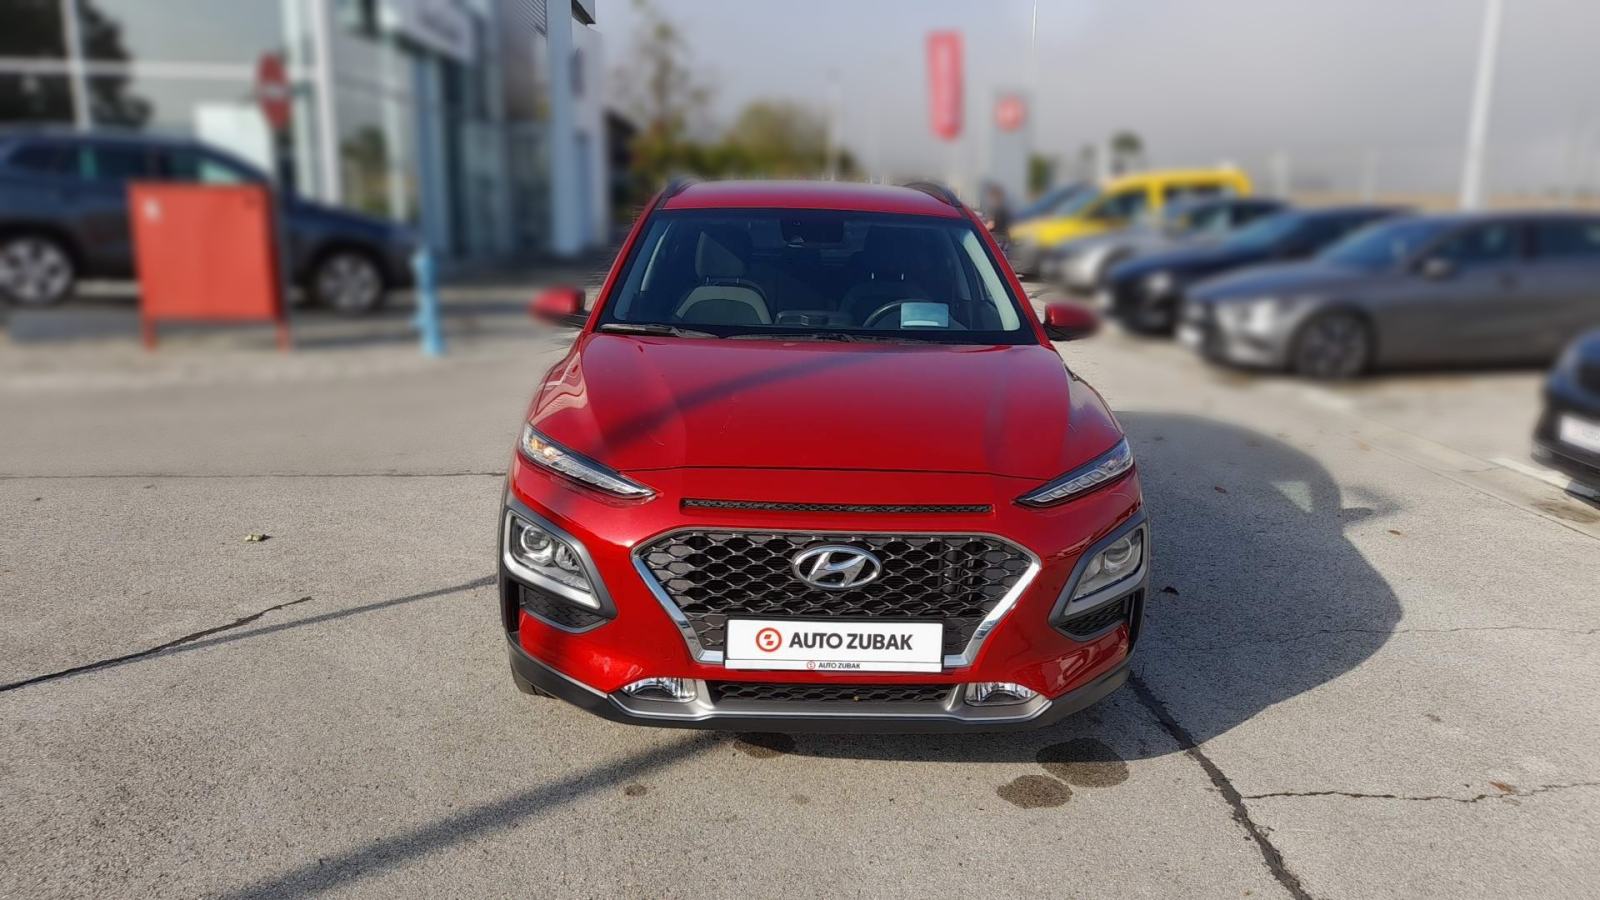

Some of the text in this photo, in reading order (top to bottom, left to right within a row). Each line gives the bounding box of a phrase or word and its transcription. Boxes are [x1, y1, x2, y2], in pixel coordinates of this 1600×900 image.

[789, 632, 913, 650] AUTO ZUBAK
[838, 662, 861, 670] ZUBAK
